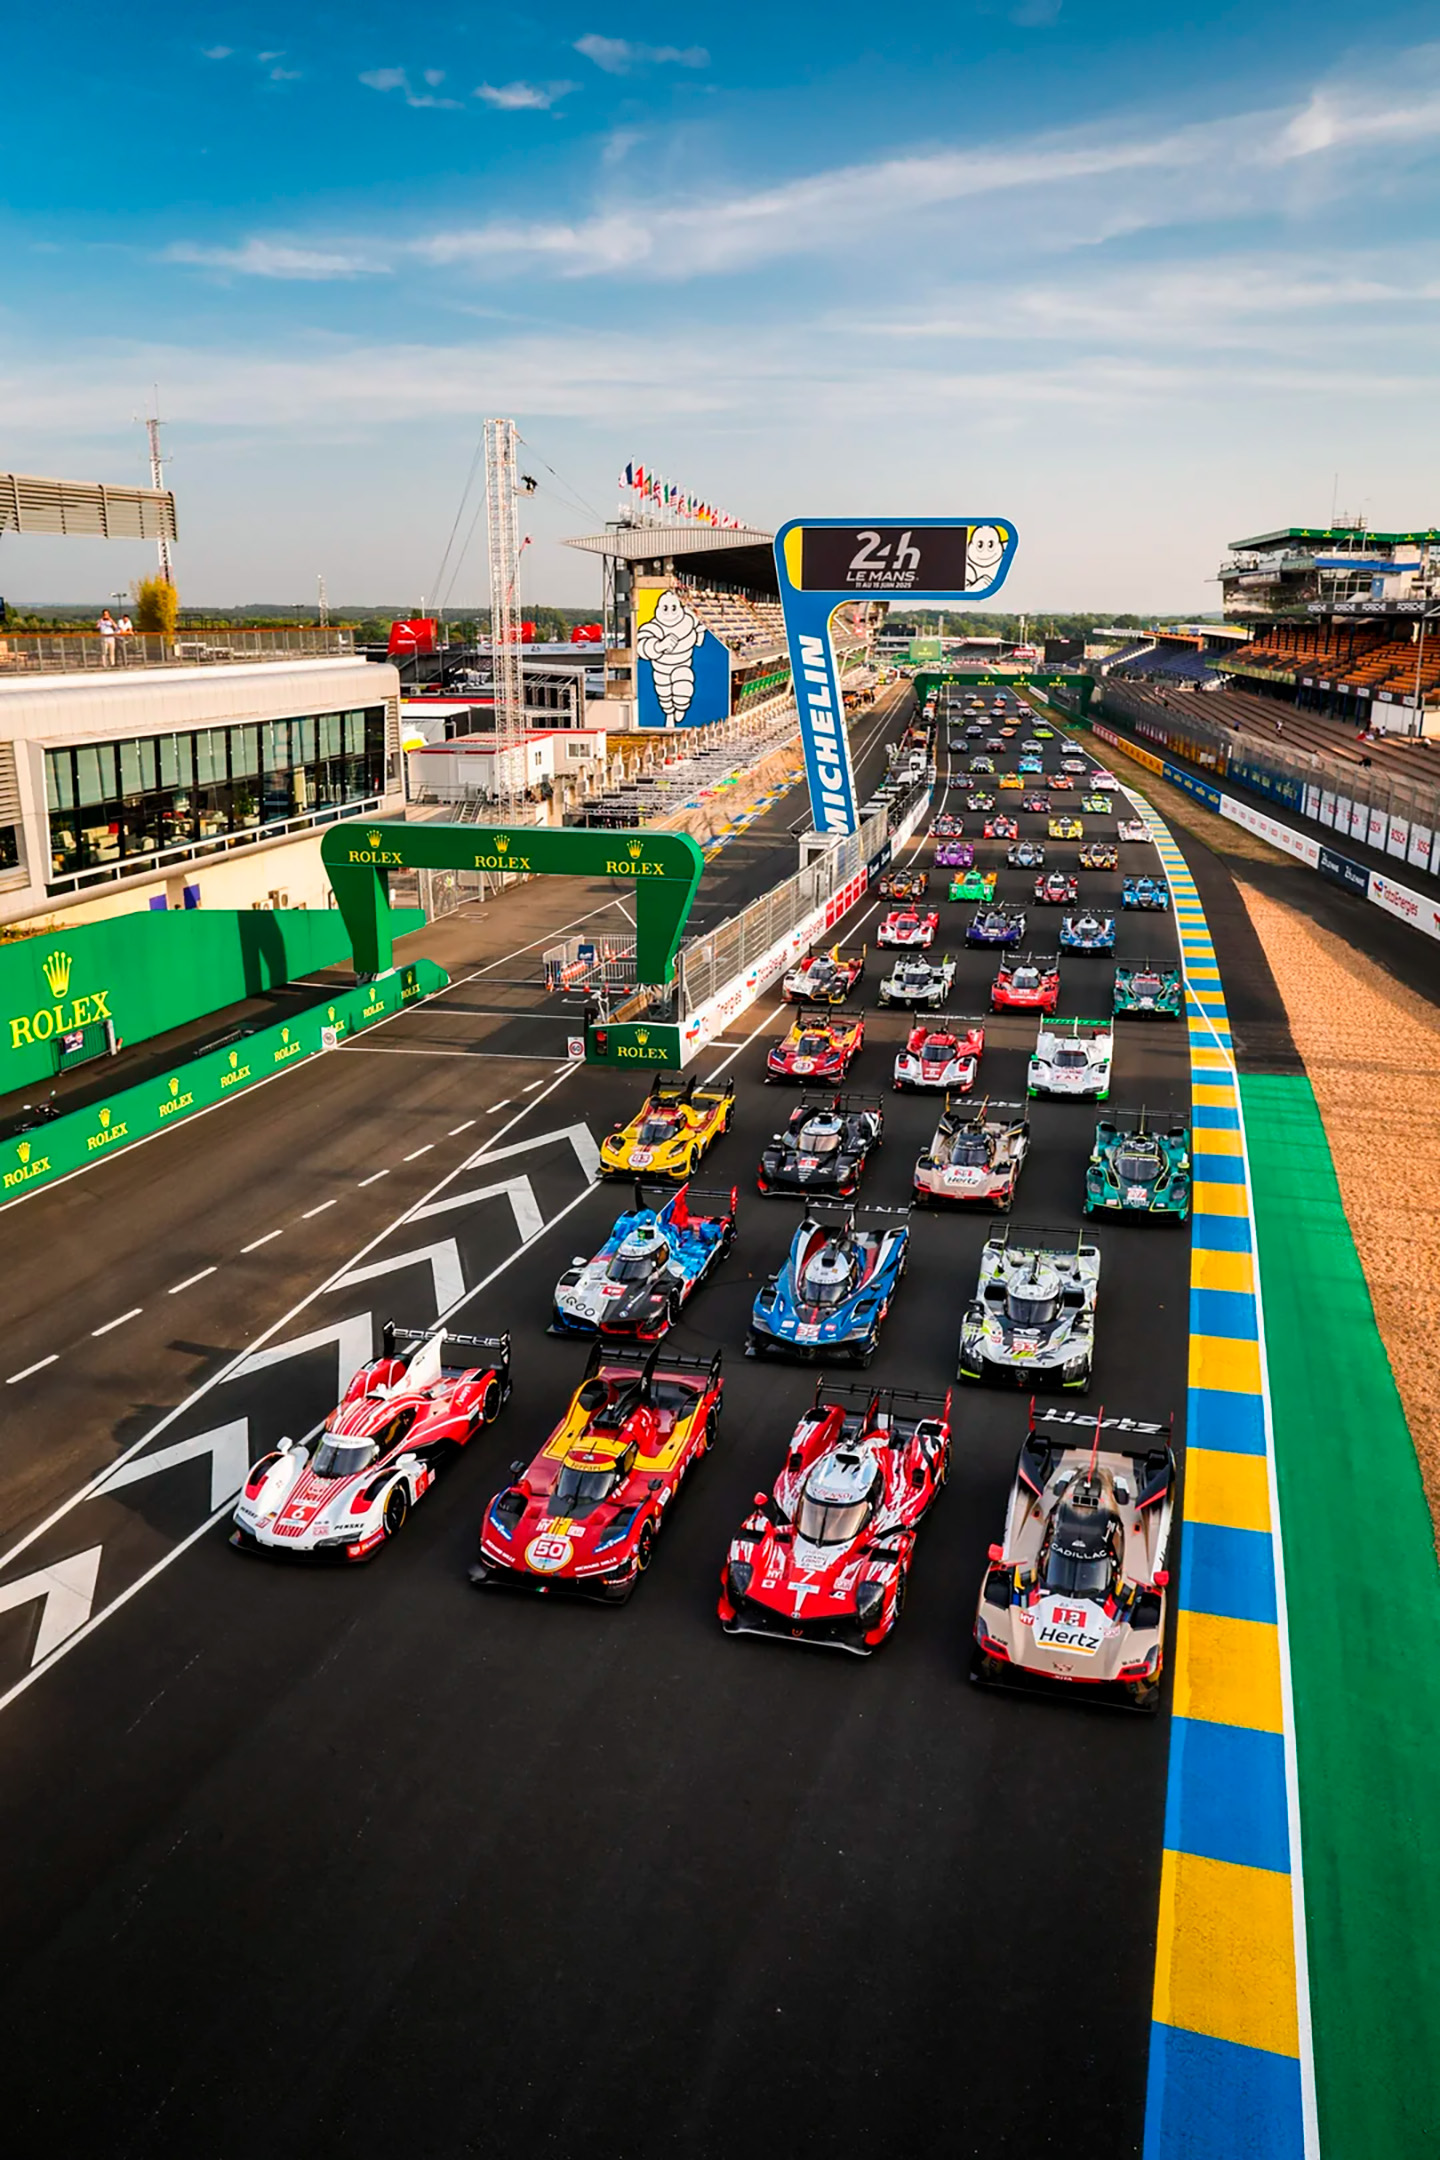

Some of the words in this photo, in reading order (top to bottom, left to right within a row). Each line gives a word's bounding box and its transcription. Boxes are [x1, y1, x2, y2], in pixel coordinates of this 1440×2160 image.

[849, 531, 921, 569] 24h
[846, 571, 867, 581] LE
[868, 571, 916, 581] MANS
[798, 634, 850, 836] MICHELIN
[348, 850, 403, 865] ROLEX
[474, 855, 531, 870] ROLEX
[606, 861, 665, 876] ROLEX
[362, 1000, 385, 1018] ROLEX
[9, 991, 112, 1048] ROLEX
[274, 1041, 301, 1063] ROLEX
[617, 1046, 668, 1059] ROLEX
[220, 1065, 251, 1089] ROLEX
[159, 1093, 194, 1118] ROLEX
[87, 1122, 129, 1151] ROLEX
[3, 1157, 52, 1188] ROLEX
[392, 1328, 501, 1346] PORSCHE
[1041, 1408, 1162, 1434] Hertz
[291, 1506, 305, 1519] 6
[535, 1541, 564, 1558] 50
[1051, 1542, 1107, 1559] CADILLAC
[800, 1569, 816, 1584] 7
[1019, 1612, 1035, 1626] HY
[1057, 1610, 1080, 1627] 12
[1039, 1626, 1100, 1650] Hertz
